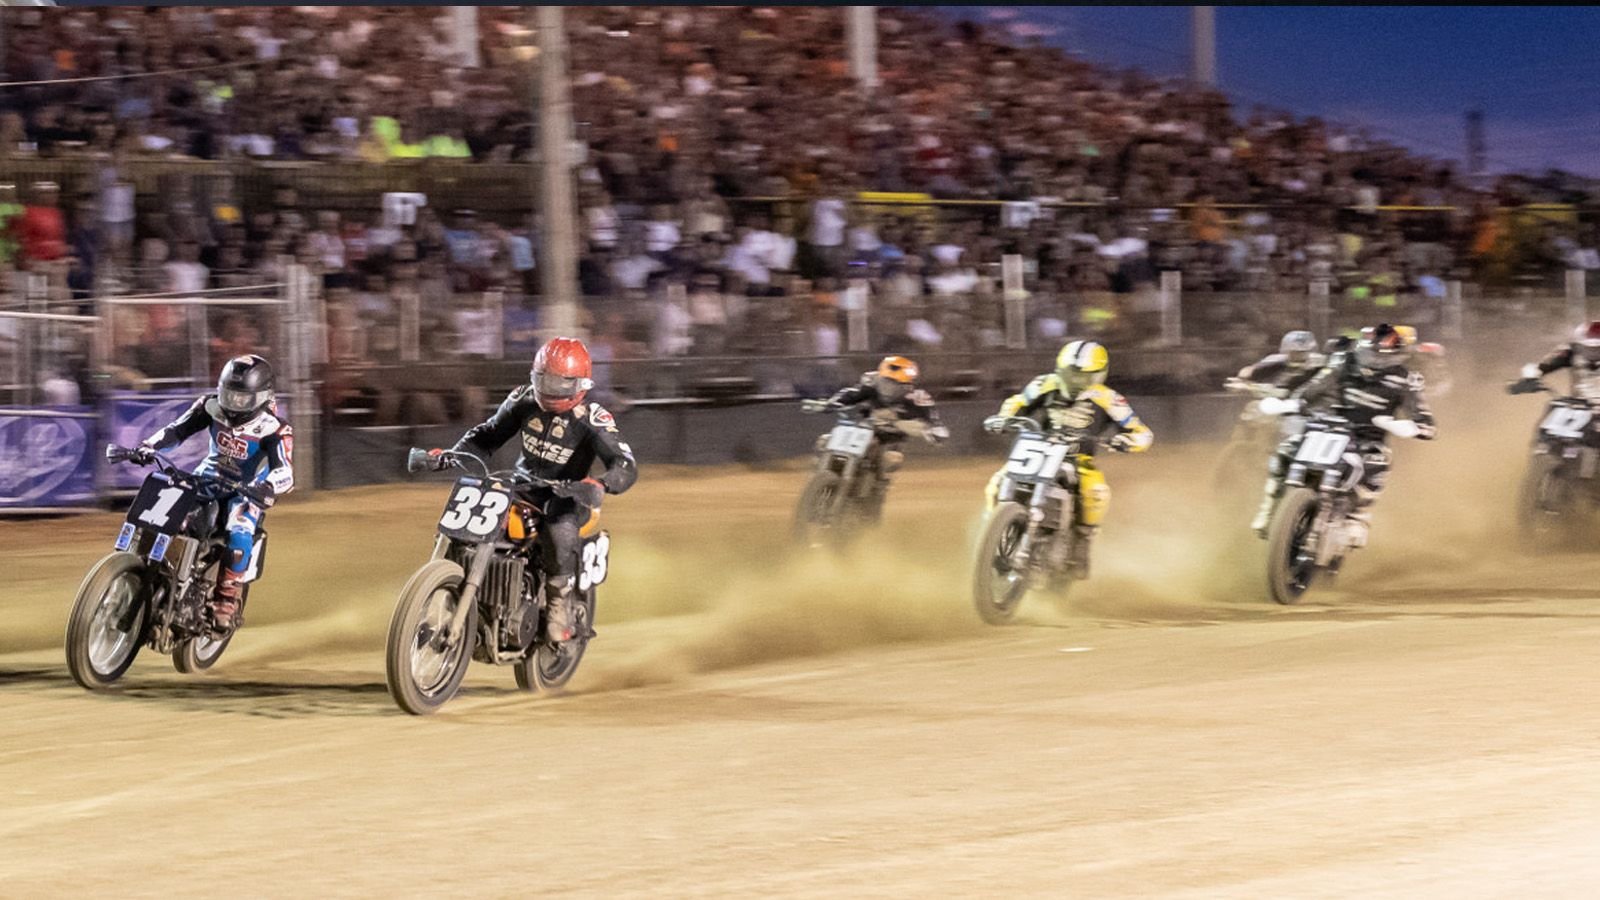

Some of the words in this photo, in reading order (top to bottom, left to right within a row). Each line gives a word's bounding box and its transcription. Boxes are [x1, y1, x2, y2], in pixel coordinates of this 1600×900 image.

[1007, 439, 1070, 479] 51
[1295, 431, 1350, 464] 10
[138, 487, 184, 527] 1
[440, 486, 509, 535] 33
[579, 535, 610, 590] 33
